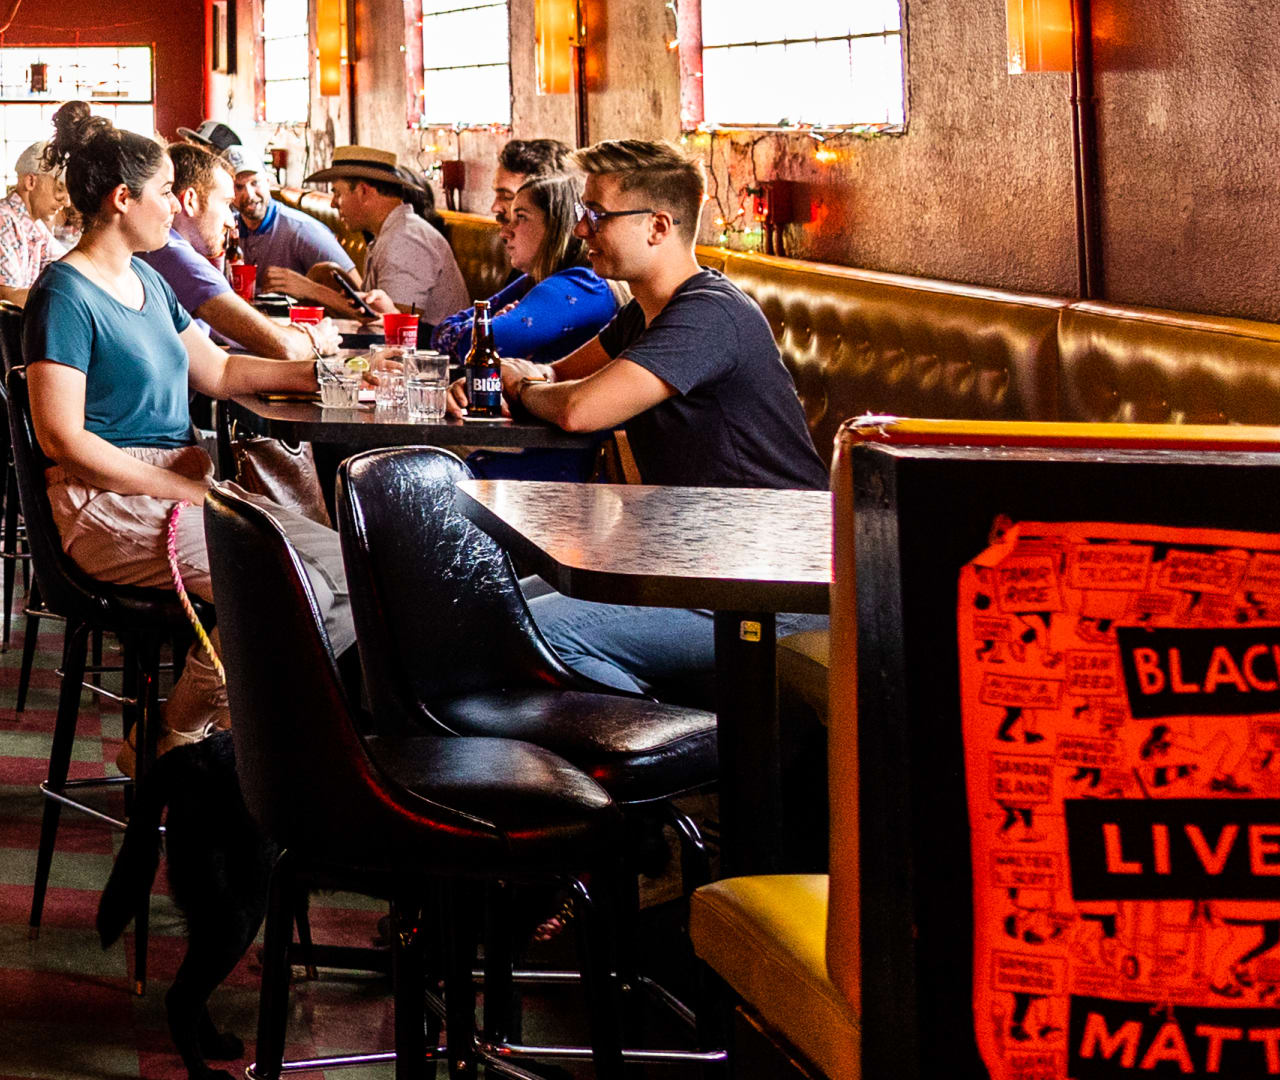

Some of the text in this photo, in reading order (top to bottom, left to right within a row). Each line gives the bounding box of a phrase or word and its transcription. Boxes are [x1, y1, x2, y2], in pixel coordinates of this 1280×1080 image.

[473, 378, 501, 392] Blue
[1132, 643, 1280, 696] BLAC
[1102, 822, 1280, 877] LIVE
[1079, 1011, 1280, 1074] MATT
